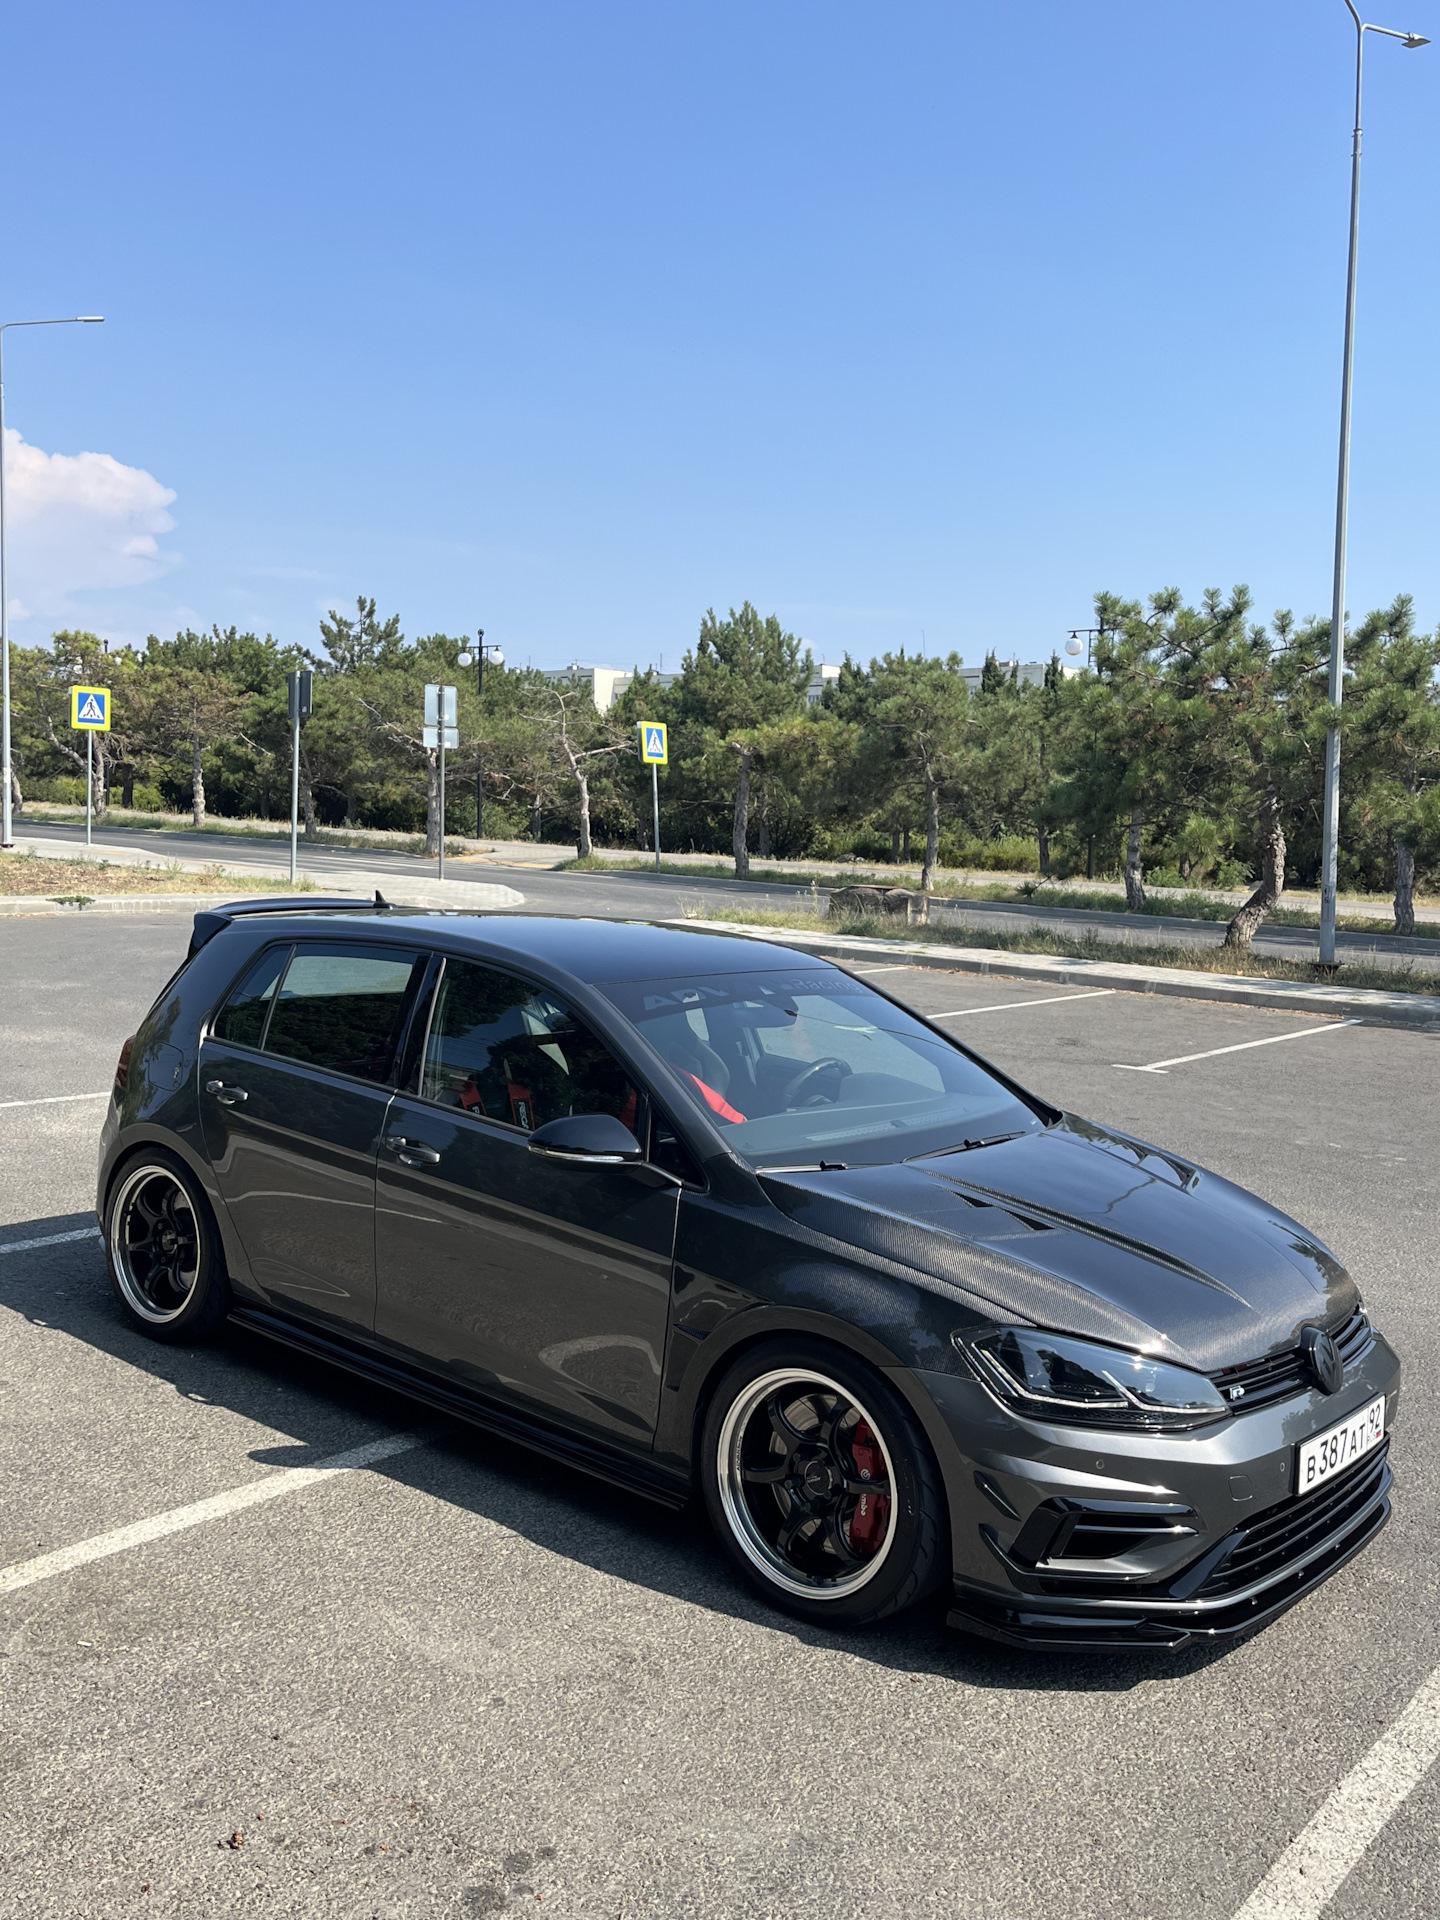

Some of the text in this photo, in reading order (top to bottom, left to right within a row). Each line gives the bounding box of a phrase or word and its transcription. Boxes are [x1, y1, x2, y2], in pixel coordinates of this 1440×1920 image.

[791, 977, 864, 993] Racing
[518, 1102, 529, 1129] RECA
[1369, 1403, 1381, 1433] 92
